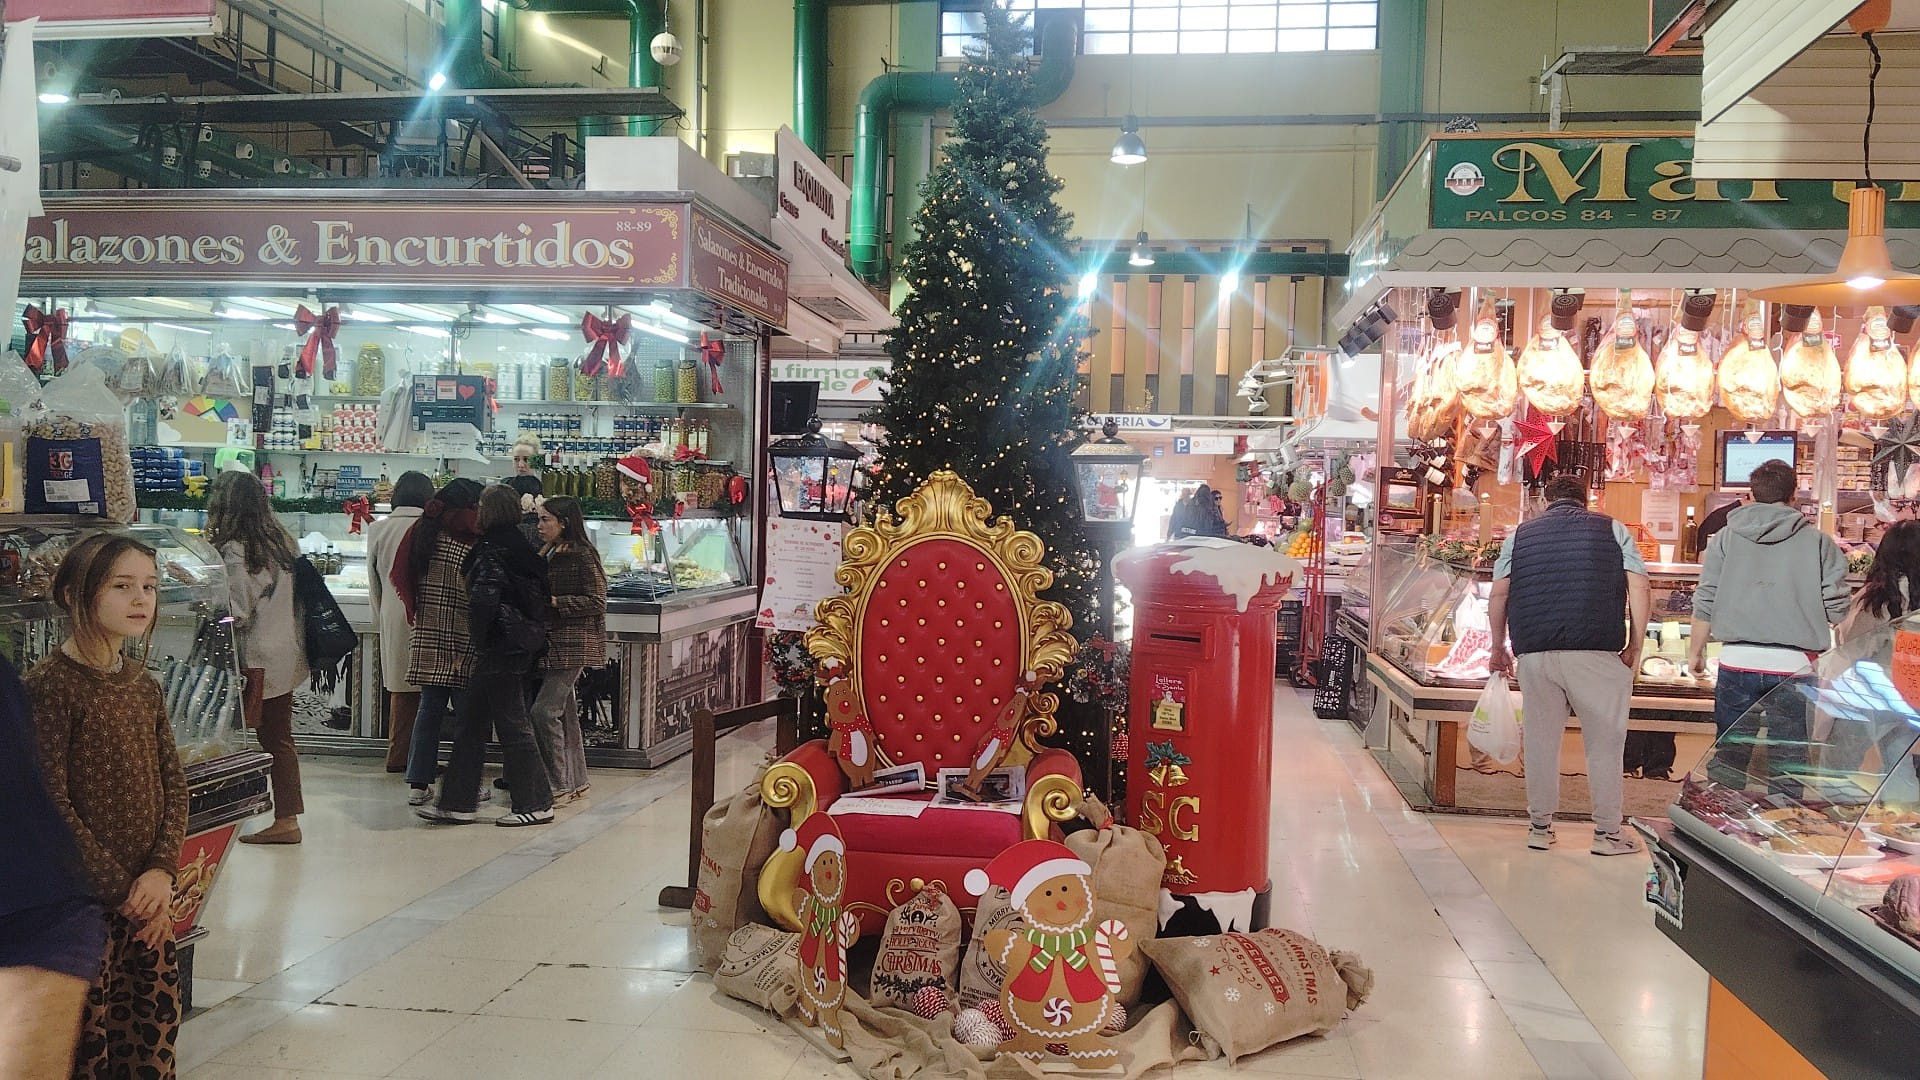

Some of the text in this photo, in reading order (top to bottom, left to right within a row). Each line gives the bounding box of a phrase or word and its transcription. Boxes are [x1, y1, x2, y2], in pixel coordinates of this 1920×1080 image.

[1465, 210, 1567, 222] PALCOS
[1580, 209, 1613, 222] 84
[1651, 209, 1682, 222] 87
[615, 220, 652, 232] 88-89
[25, 218, 634, 269] alazones & Encurtidos
[697, 226, 783, 290] Salazones & Encurtidos
[718, 265, 769, 310] Tradicionales
[785, 363, 860, 379] firma
[819, 375, 848, 391] de
[1177, 438, 1188, 452] P
[1155, 674, 1183, 685] Letters
[1140, 789, 1200, 842] SG
[1163, 874, 1189, 885] PRESS
[988, 905, 1010, 927] MERRY
[882, 951, 942, 977] CHRISTMAS
[1230, 947, 1252, 975] 25TH
